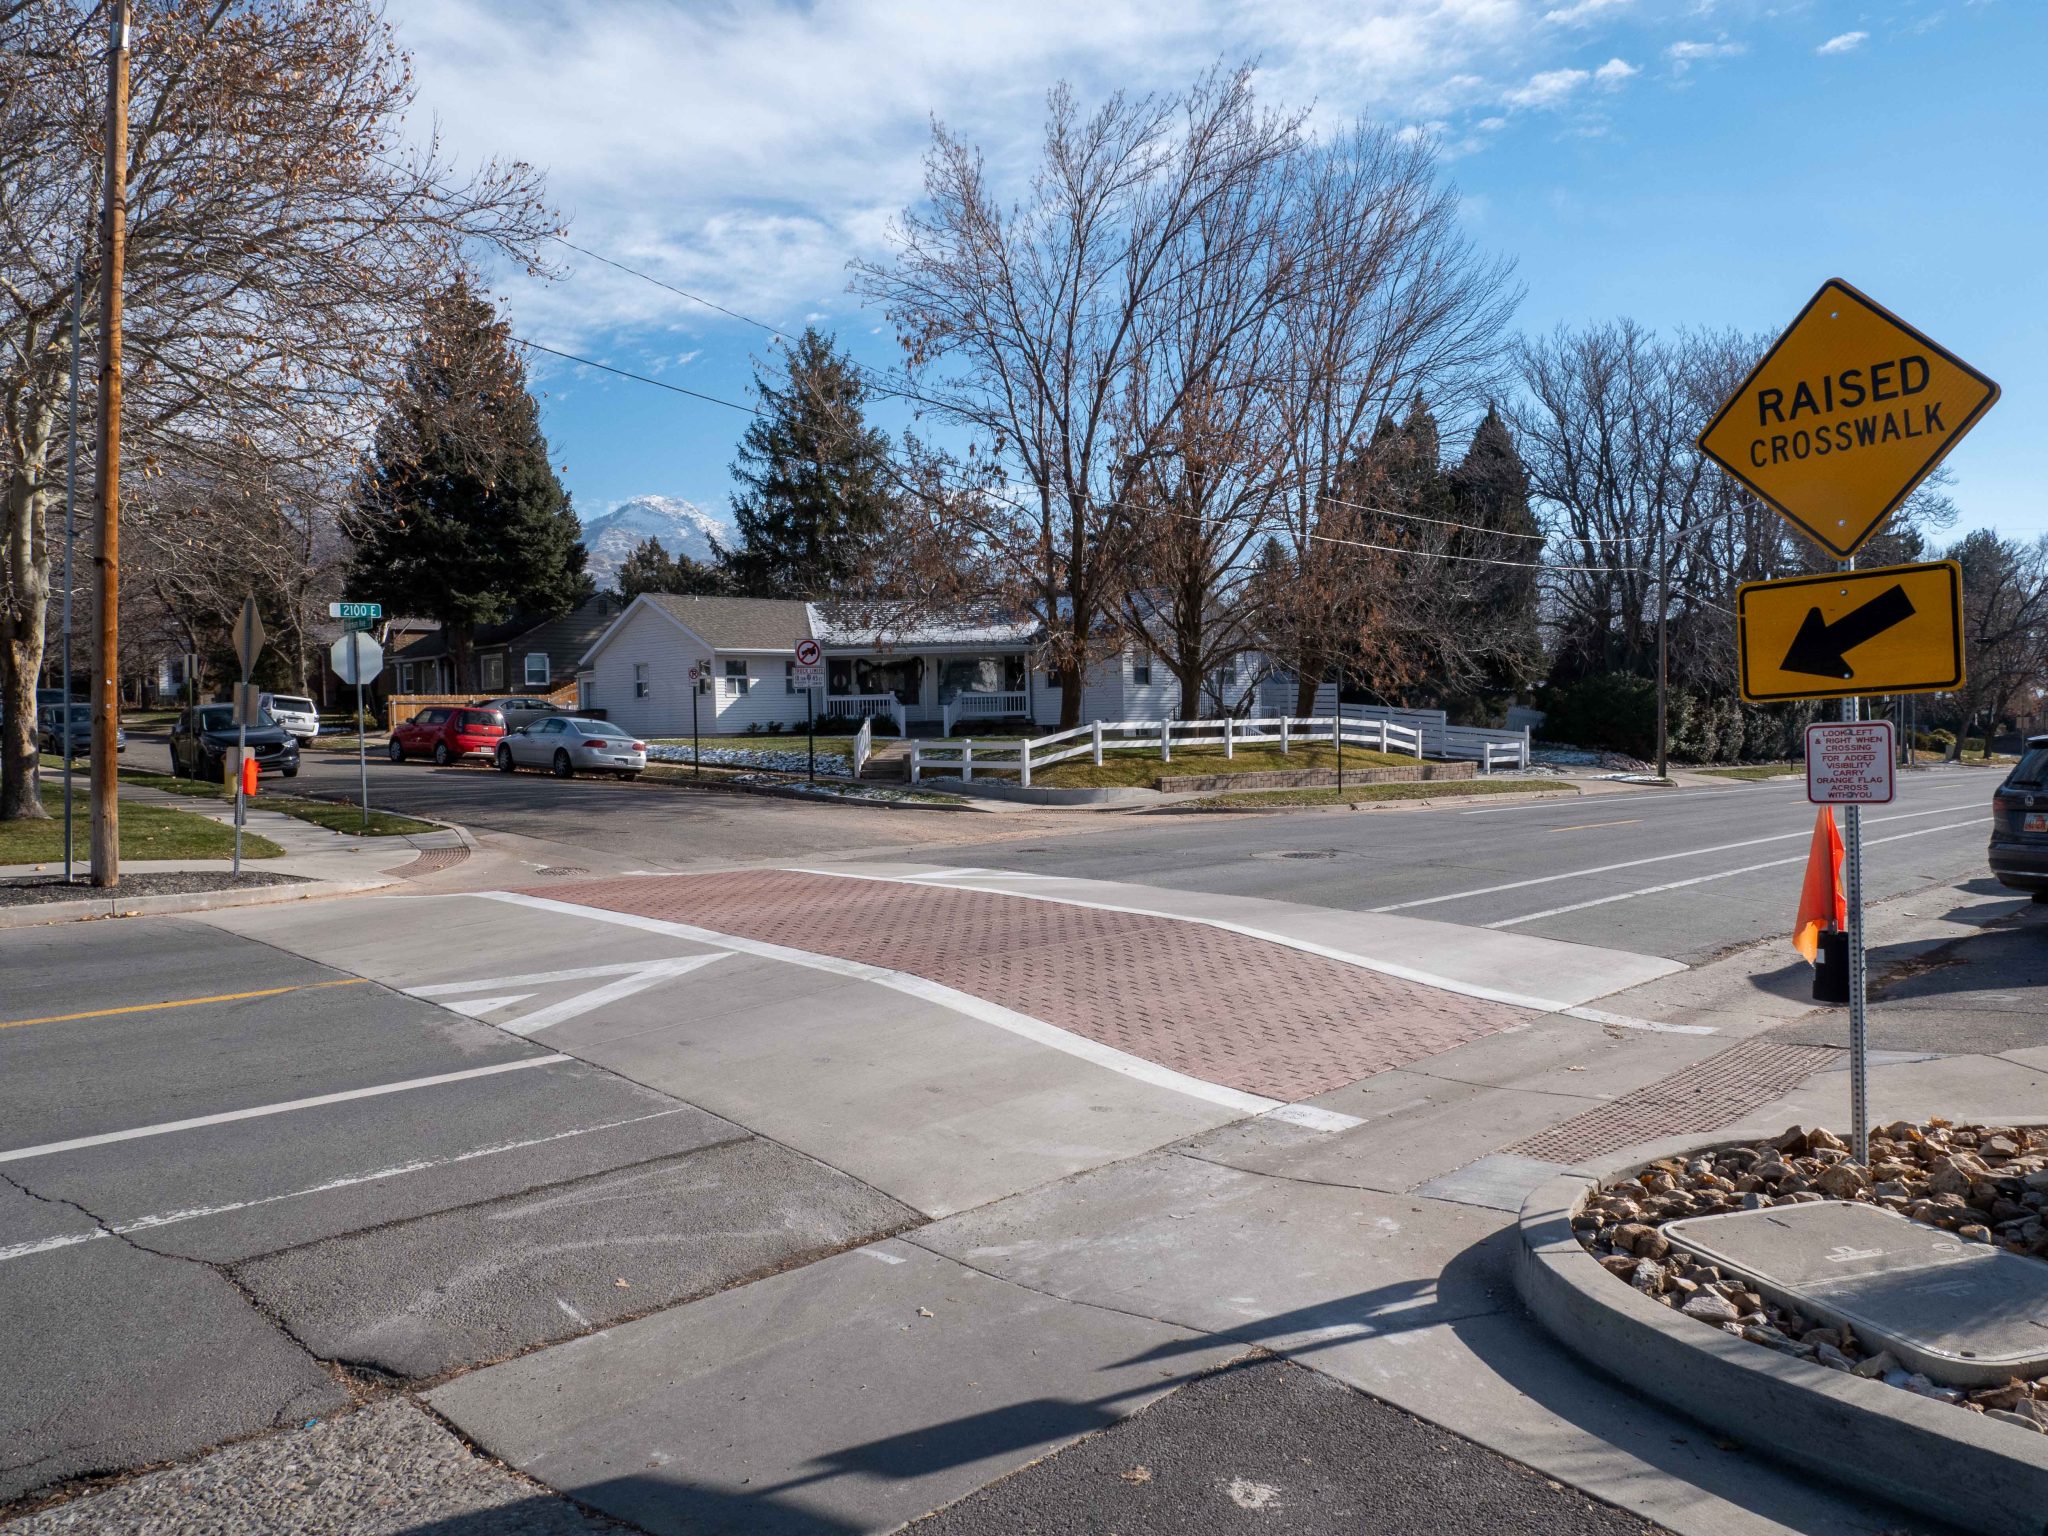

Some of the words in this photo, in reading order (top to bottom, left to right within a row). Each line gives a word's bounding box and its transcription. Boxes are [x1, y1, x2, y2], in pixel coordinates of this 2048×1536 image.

[1758, 355, 1930, 426] RAISED
[1750, 402, 1945, 468] CROSSWALK
[343, 605, 367, 616] 2100
[370, 605, 376, 616] E
[1825, 744, 1872, 752] CROSSING
[1832, 769, 1865, 777] CARRY
[1830, 784, 1870, 792] ACROSS
[1827, 791, 1849, 799] WITH
[1853, 791, 1873, 799] YOU
